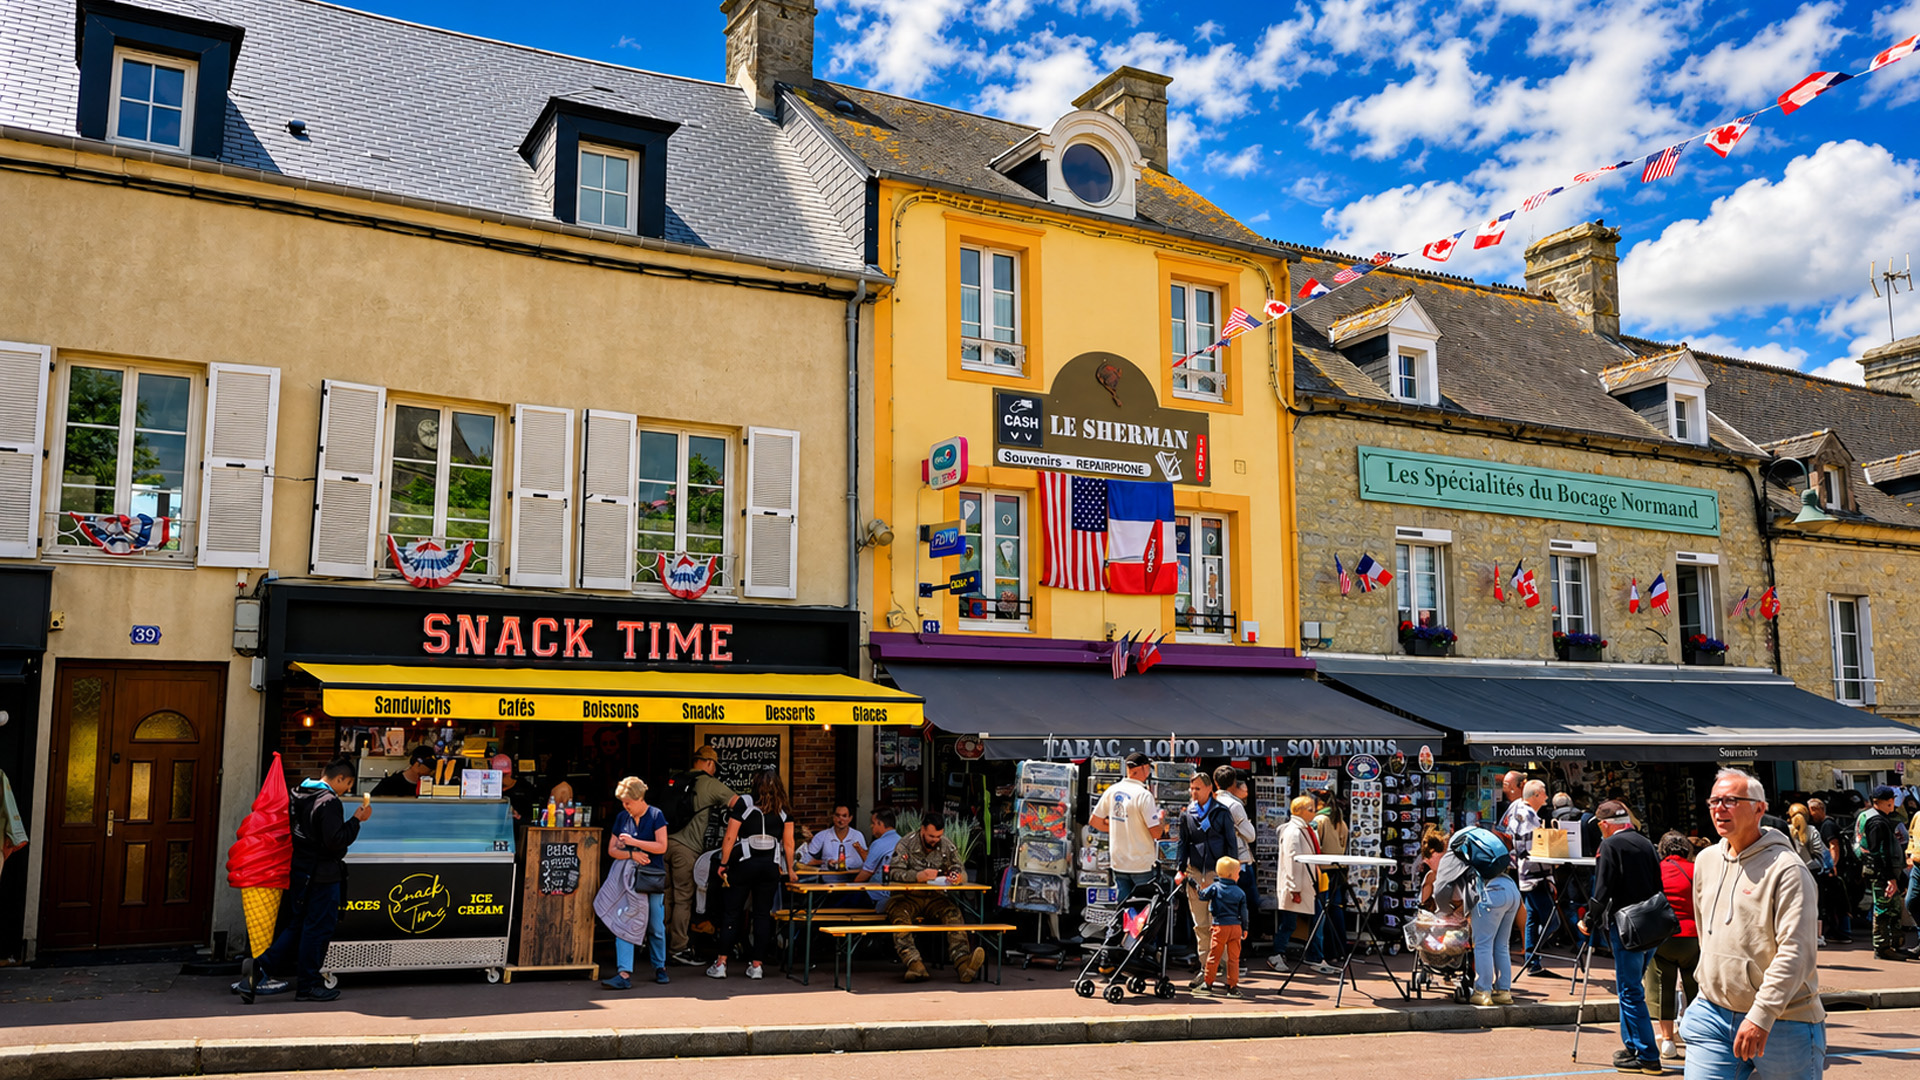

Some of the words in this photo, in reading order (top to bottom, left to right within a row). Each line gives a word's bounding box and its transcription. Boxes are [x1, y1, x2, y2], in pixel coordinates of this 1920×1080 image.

[1004, 414, 1039, 429] CASH
[1050, 415, 1077, 437] LE
[1083, 418, 1189, 450] SHERMAN
[1004, 451, 1062, 467] Souvenirs
[1076, 459, 1144, 475] REPAIRPHONE
[1386, 462, 1419, 485] Les
[1424, 466, 1525, 497] Spécialités
[1529, 479, 1553, 501] du
[1557, 483, 1617, 515] Bocage
[1621, 491, 1699, 519] Normand
[135, 627, 156, 642] 39
[925, 622, 936, 632] 41
[423, 613, 593, 658] SNACK
[617, 620, 733, 661] TIME
[374, 694, 451, 716] Sandwichs
[498, 697, 535, 717] Cafés
[583, 700, 639, 719] Boissons
[682, 702, 725, 720] Snacks
[766, 704, 815, 721] Desserts
[852, 706, 888, 722] Glaces
[710, 736, 778, 749] SANDWICHS
[1043, 739, 1121, 757] TABAC
[1142, 739, 1200, 757] LOTO
[1221, 739, 1266, 756] PMU
[1287, 739, 1397, 756] SOUVENIRS
[388, 874, 445, 913] Snack
[470, 893, 493, 904] ICE
[457, 905, 504, 915] CREAM
